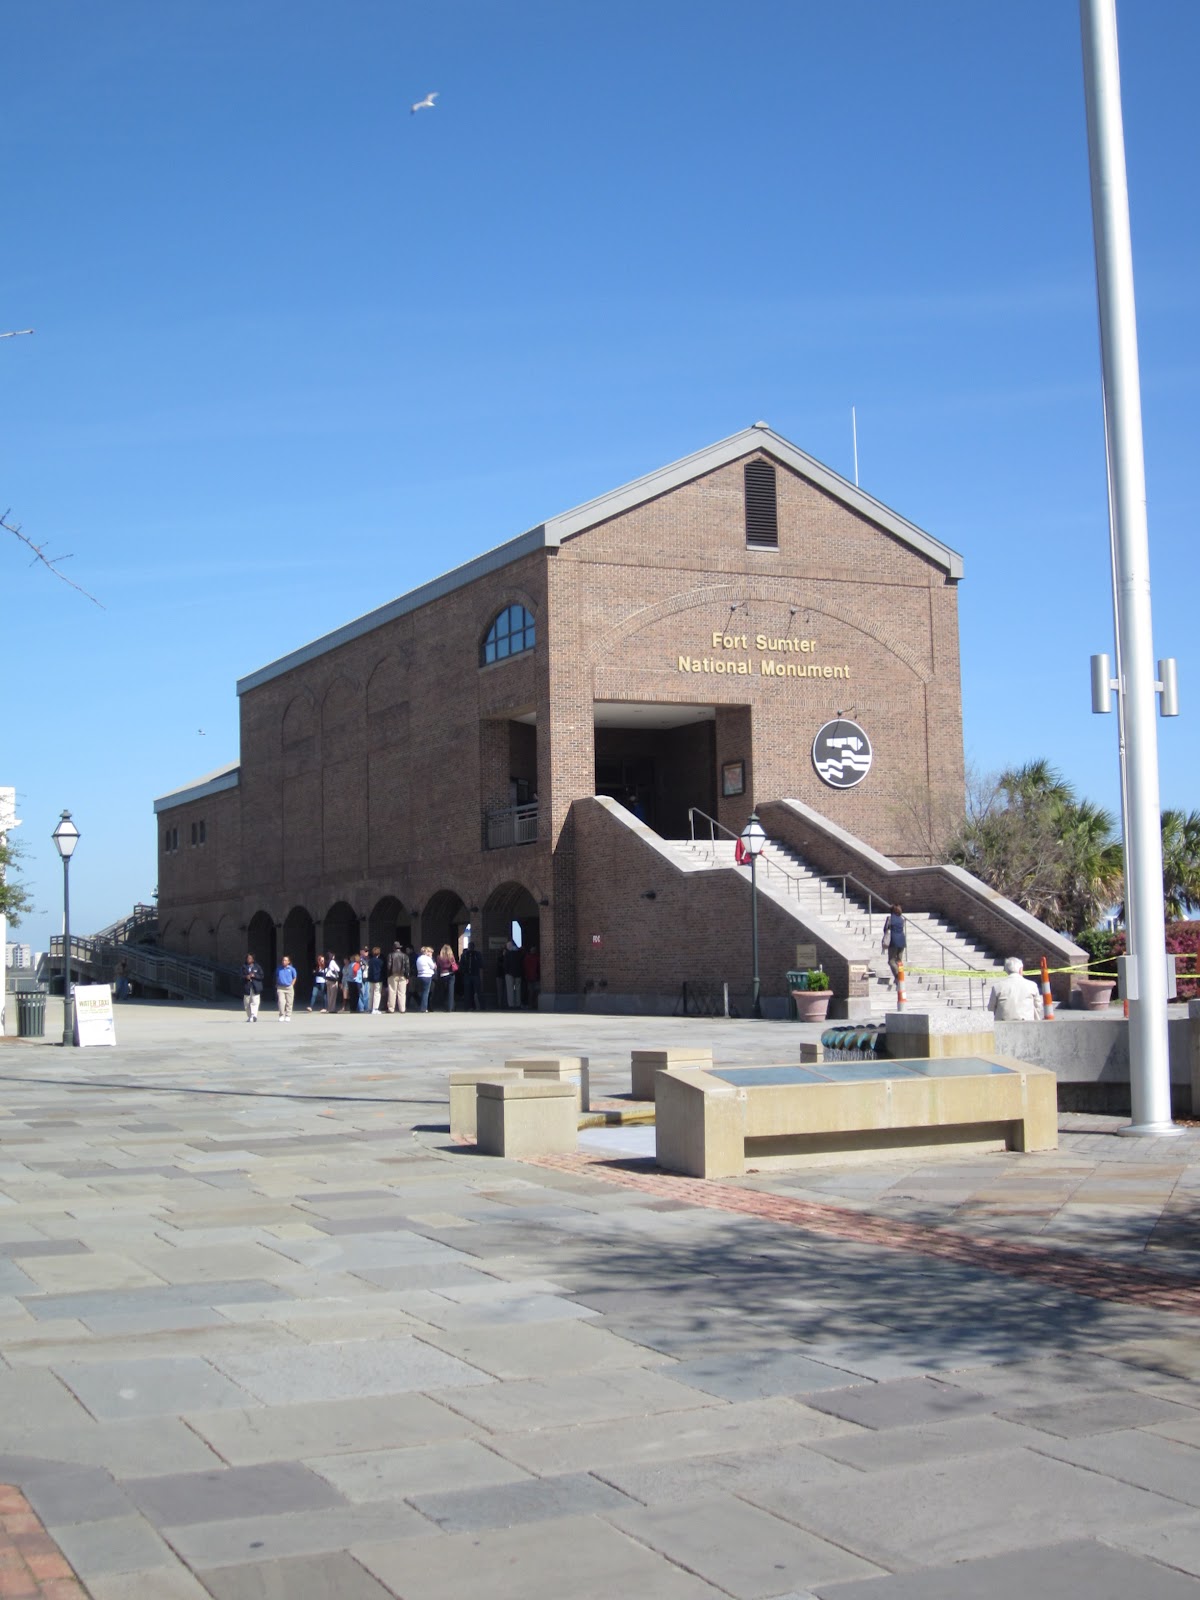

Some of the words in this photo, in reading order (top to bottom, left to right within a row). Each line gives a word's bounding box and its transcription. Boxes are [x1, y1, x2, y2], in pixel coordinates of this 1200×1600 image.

[712, 632, 747, 649] Fort
[756, 634, 816, 652] Sumter
[678, 656, 752, 675] National
[761, 660, 850, 679] Monument
